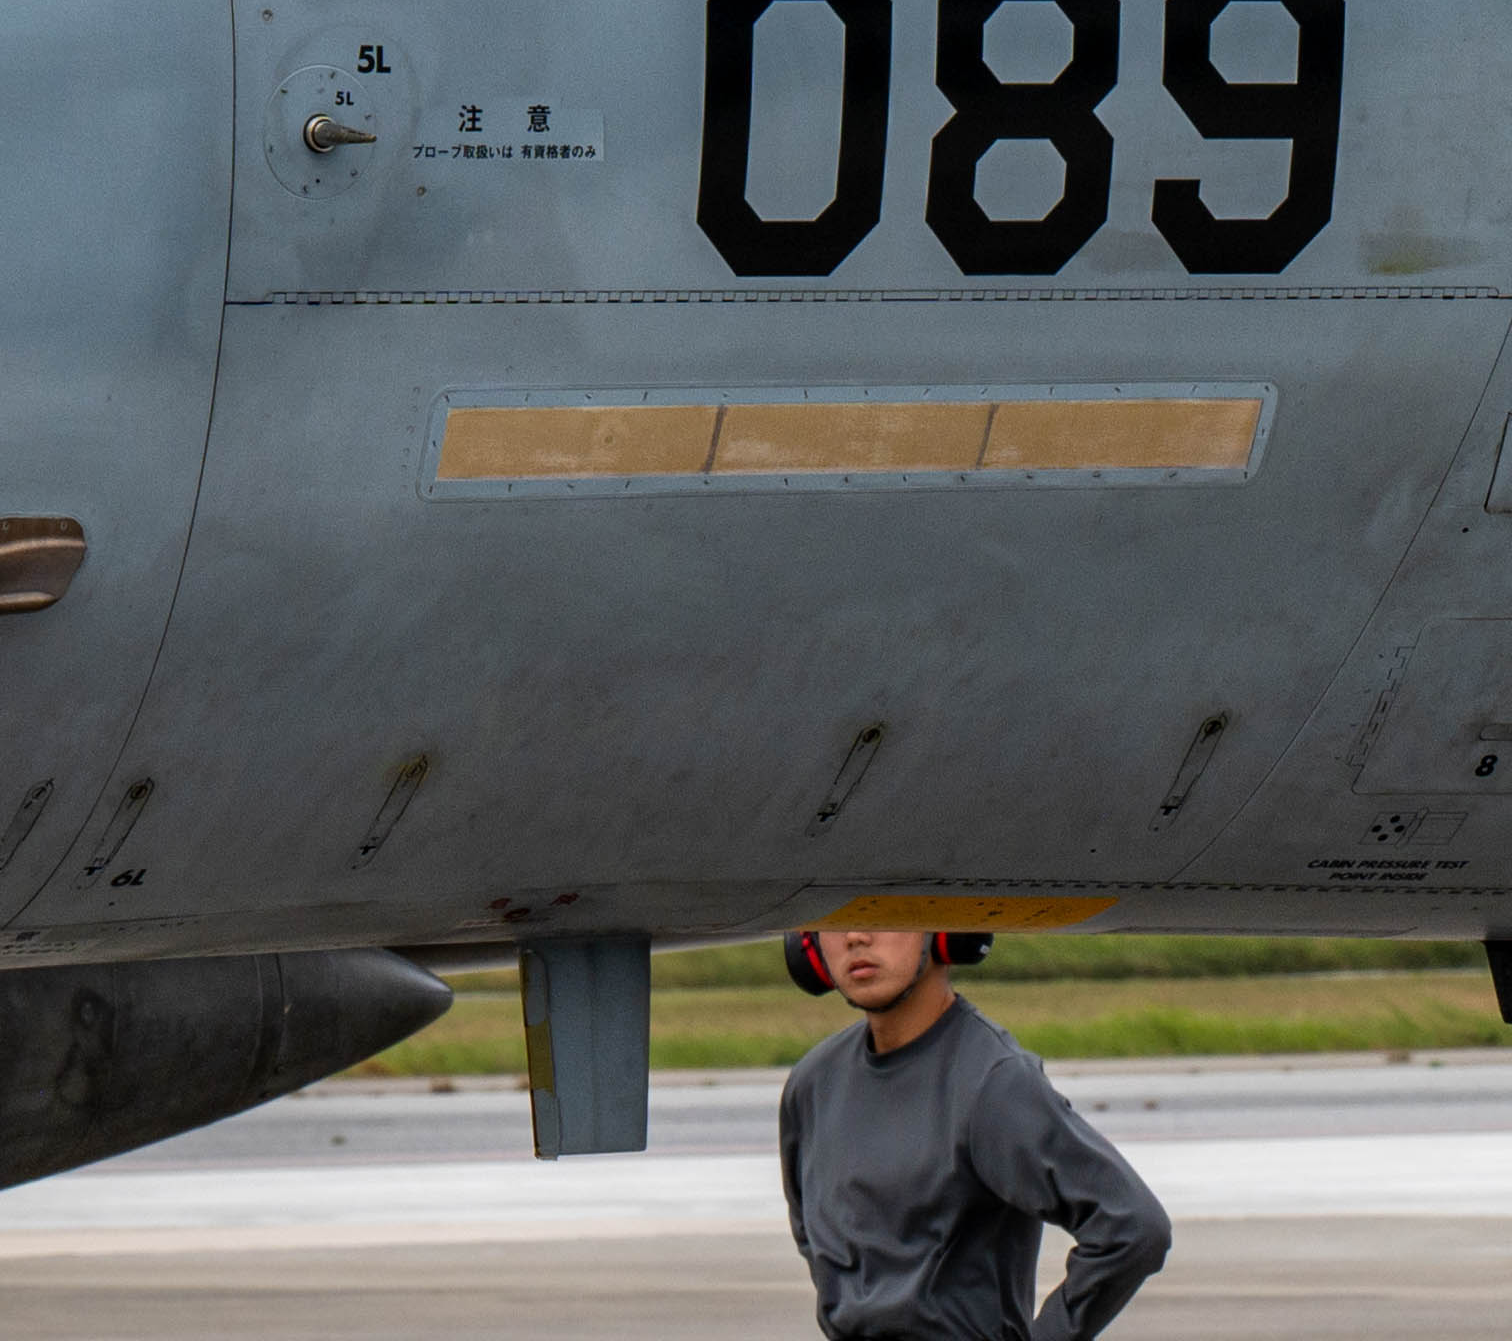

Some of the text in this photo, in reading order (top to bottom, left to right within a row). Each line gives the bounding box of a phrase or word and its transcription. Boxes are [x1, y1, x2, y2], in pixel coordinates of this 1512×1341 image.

[357, 45, 392, 74] 5L
[335, 91, 354, 106] 5L
[458, 104, 551, 133] 注意
[1475, 755, 1498, 777] 8
[1358, 860, 1431, 869] PRESSURE
[110, 869, 147, 887] 6L
